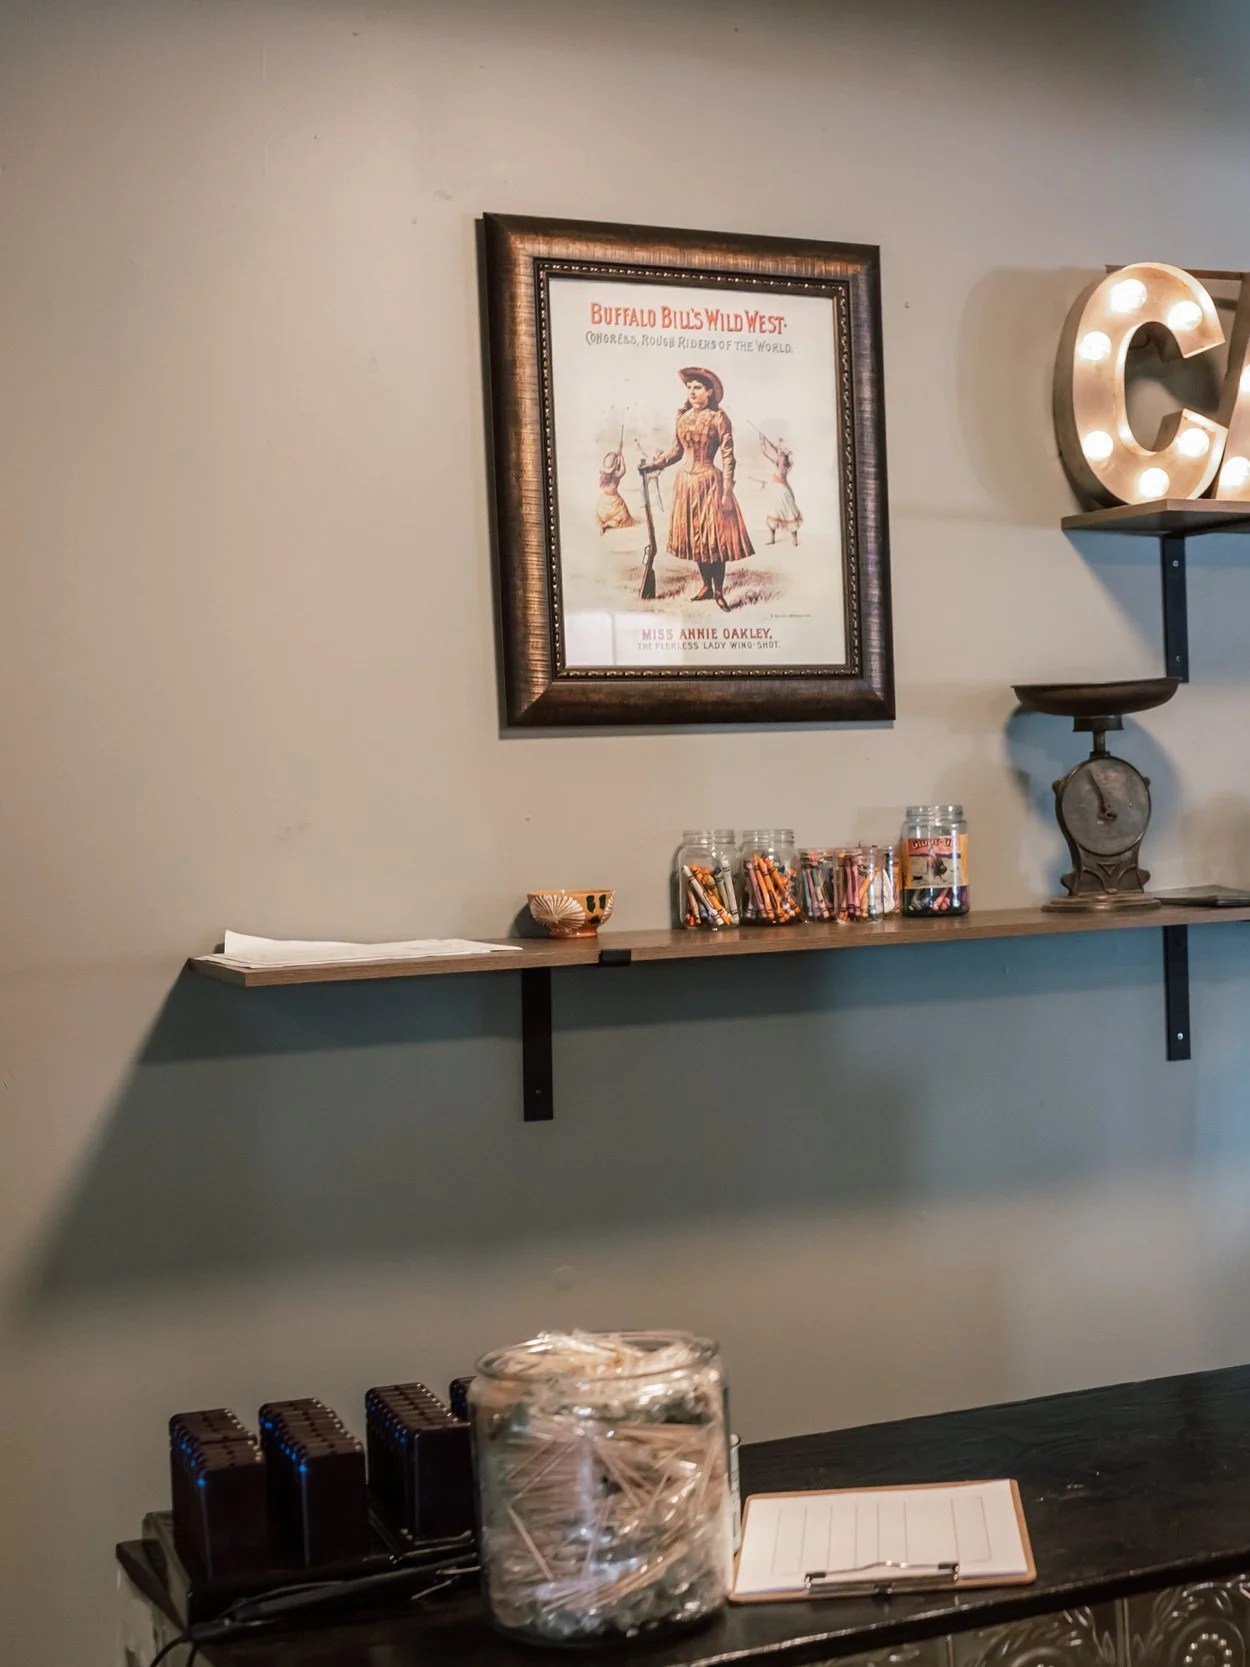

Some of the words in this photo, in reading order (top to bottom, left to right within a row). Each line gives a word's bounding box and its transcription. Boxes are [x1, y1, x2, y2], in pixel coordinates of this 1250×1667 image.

[591, 302, 656, 328] BUFFALO
[661, 305, 704, 330] BILL'S
[704, 308, 743, 332] WILD
[641, 334, 675, 349] ROUGH
[678, 336, 717, 350] RIDERS
[718, 340, 732, 351] OF
[734, 341, 753, 352] THE
[642, 629, 673, 641] MISS
[680, 628, 718, 640] ANNIE
[637, 642, 652, 651] THE
[703, 641, 726, 650] LADY
